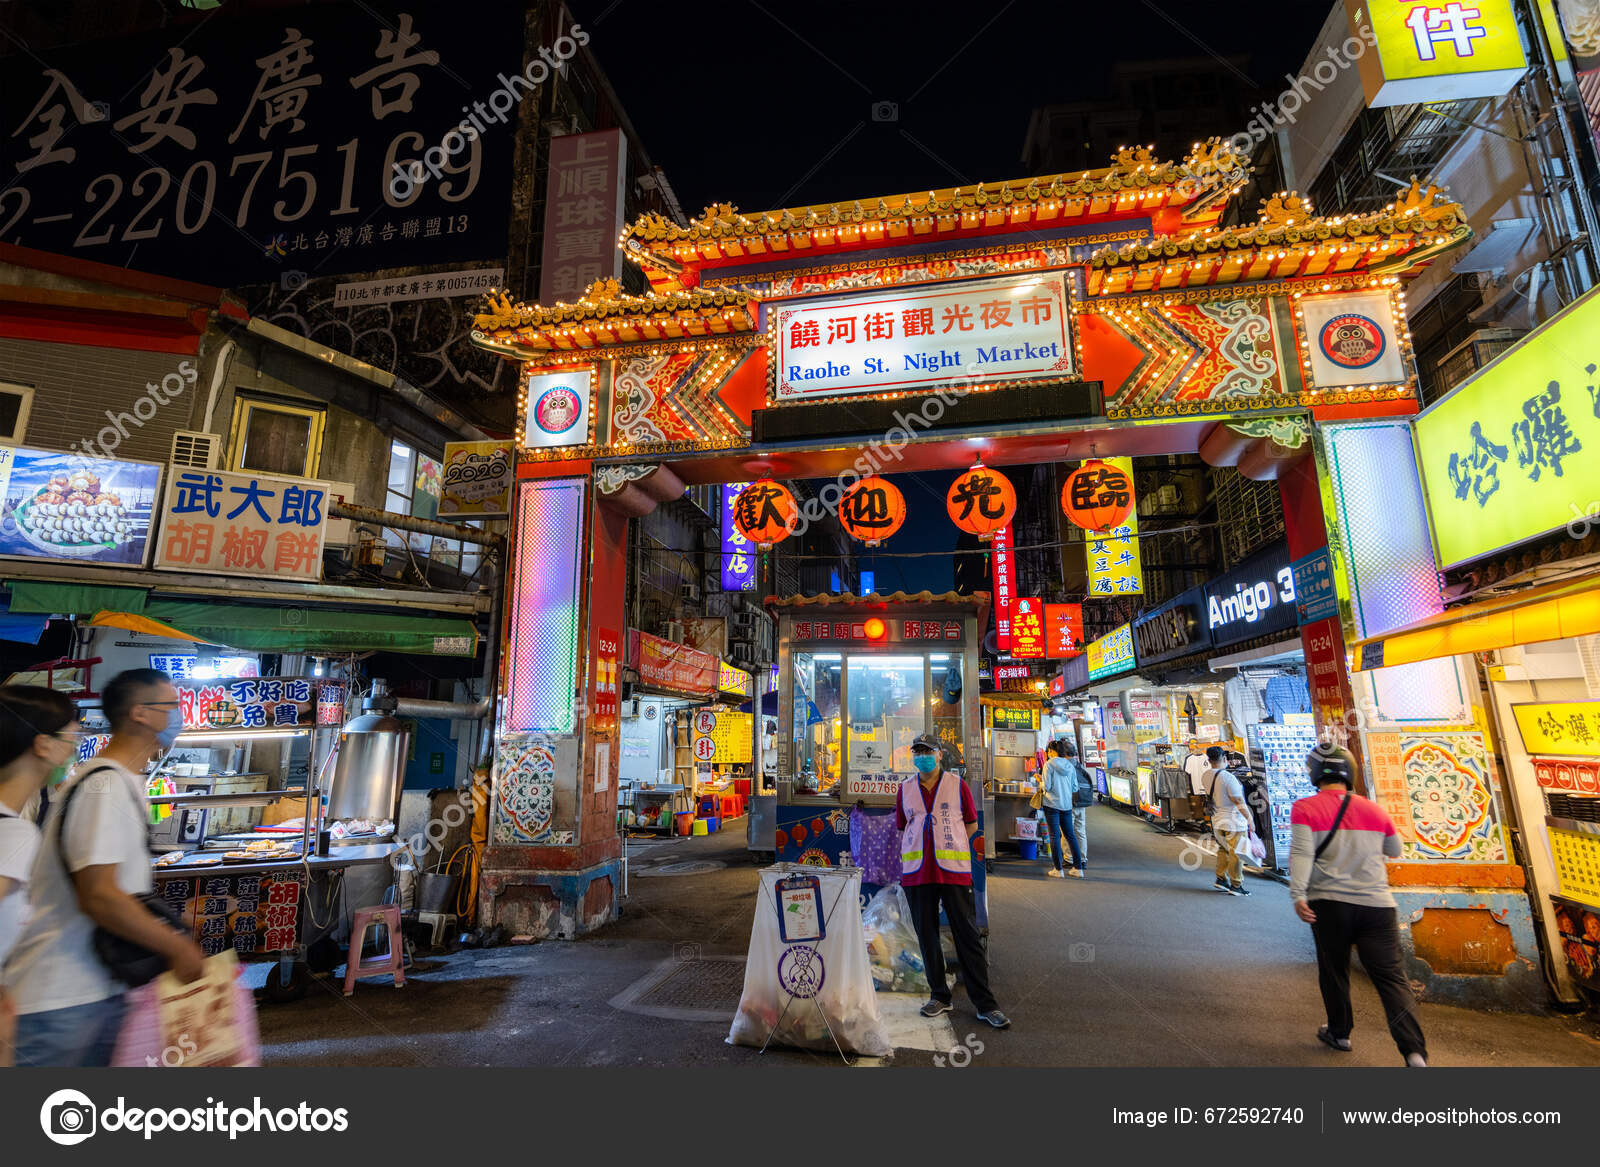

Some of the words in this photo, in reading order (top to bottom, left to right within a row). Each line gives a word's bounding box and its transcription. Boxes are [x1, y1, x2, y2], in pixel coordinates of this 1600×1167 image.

[1404, 2, 1487, 62] 件
[11, 12, 440, 174] 全安廣告
[789, 295, 1053, 350] 饒河街觀光夜市
[788, 360, 851, 382] Raohe
[863, 357, 890, 375] St.
[903, 350, 961, 372] Night
[976, 341, 1060, 365] Market
[444, 461, 507, 486] 2020
[171, 472, 324, 528] 武大郎
[734, 485, 786, 533] 歡
[841, 486, 893, 532] 迎
[951, 474, 1006, 521] 光
[1070, 468, 1130, 511] 臨
[165, 519, 319, 575] 胡椒餅
[1209, 581, 1272, 629] Amigo
[1276, 566, 1297, 603] 3
[600, 639, 617, 653] 12-24
[904, 620, 961, 640] 服務台
[1310, 635, 1332, 653] 12-24
[231, 680, 310, 704] 不好吃
[997, 668, 1028, 678] 金瑞利
[242, 703, 299, 728] 免費
[849, 781, 901, 794] (02)2766
[265, 881, 300, 952] 胡椒餅
